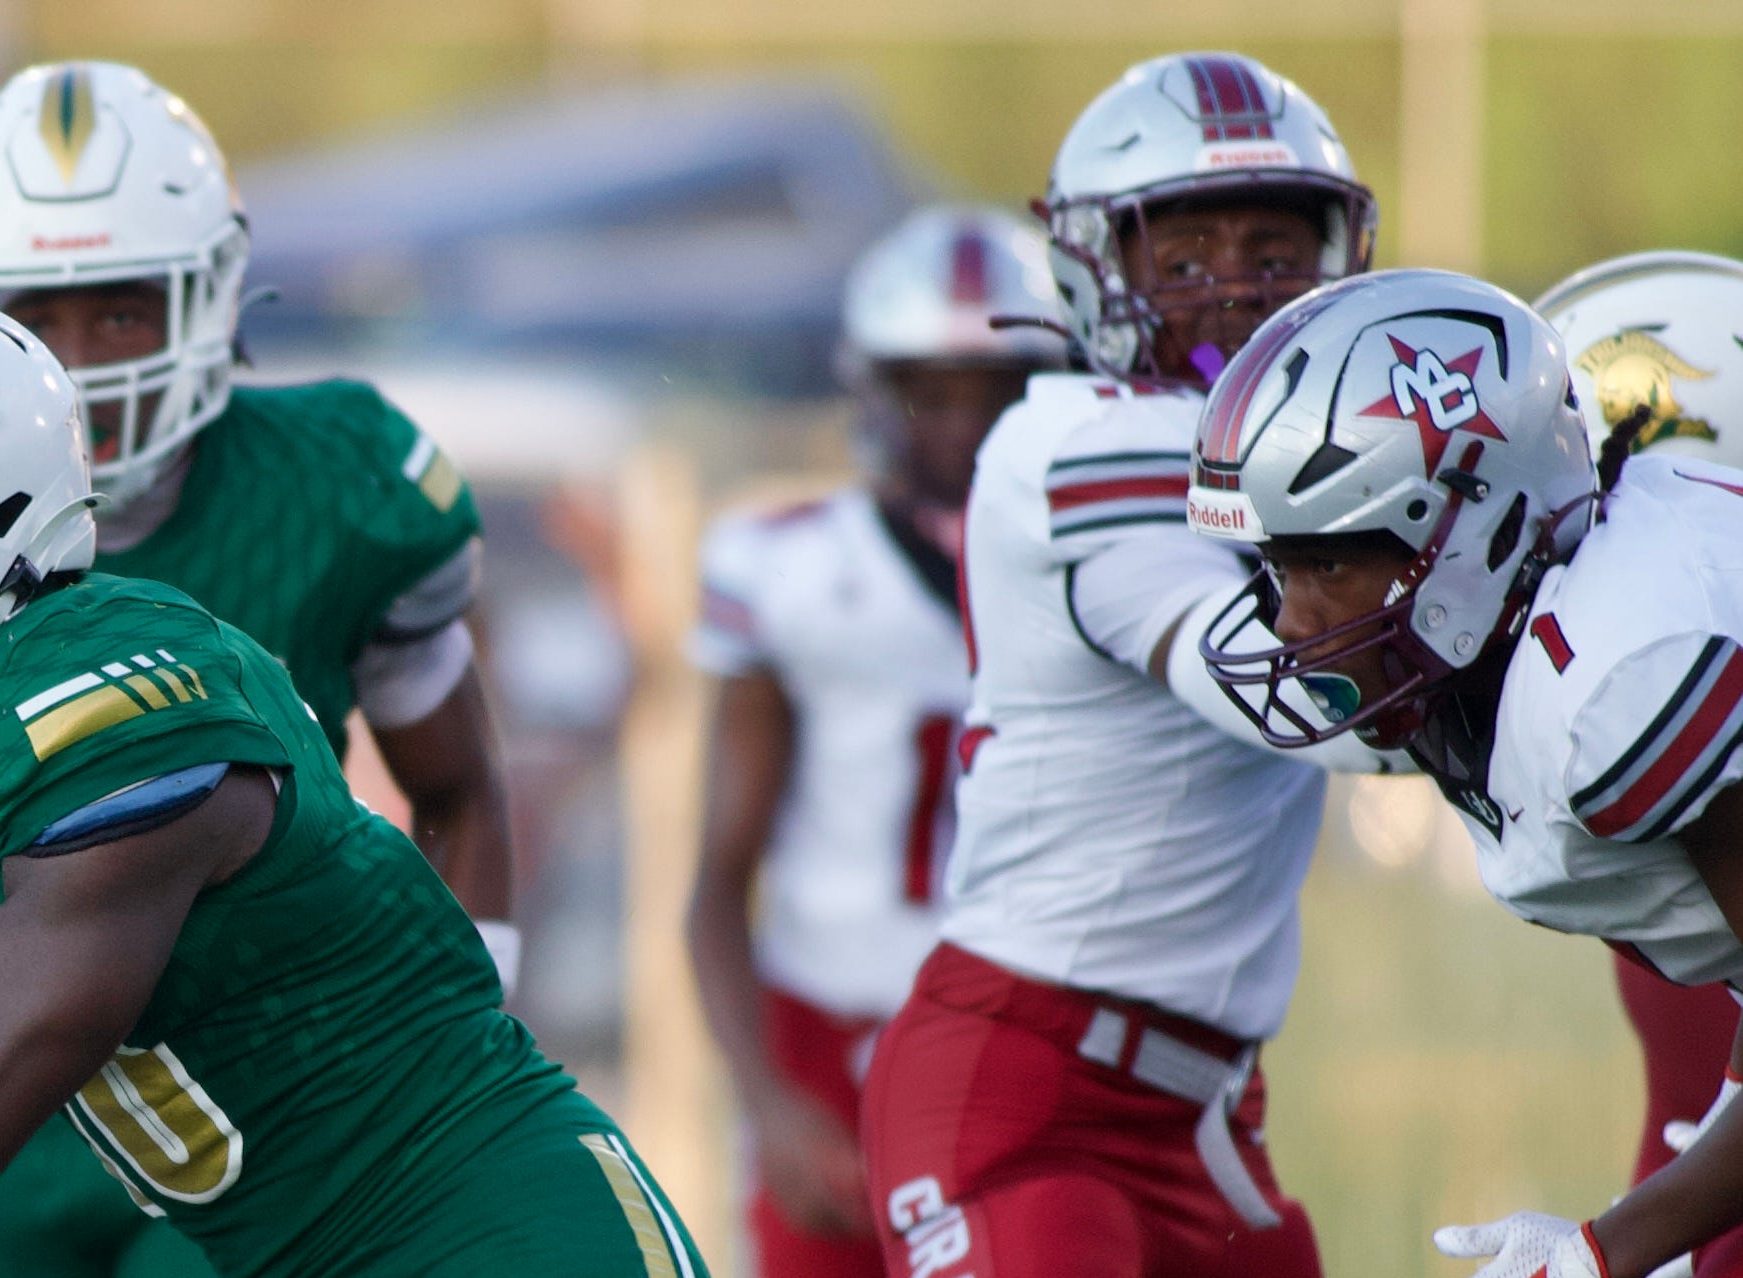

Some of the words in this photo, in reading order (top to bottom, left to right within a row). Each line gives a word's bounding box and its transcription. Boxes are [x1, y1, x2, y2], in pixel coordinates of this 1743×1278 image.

[1389, 347, 1479, 432] MC
[1189, 502, 1245, 530] Riddell
[1530, 611, 1576, 677] 1
